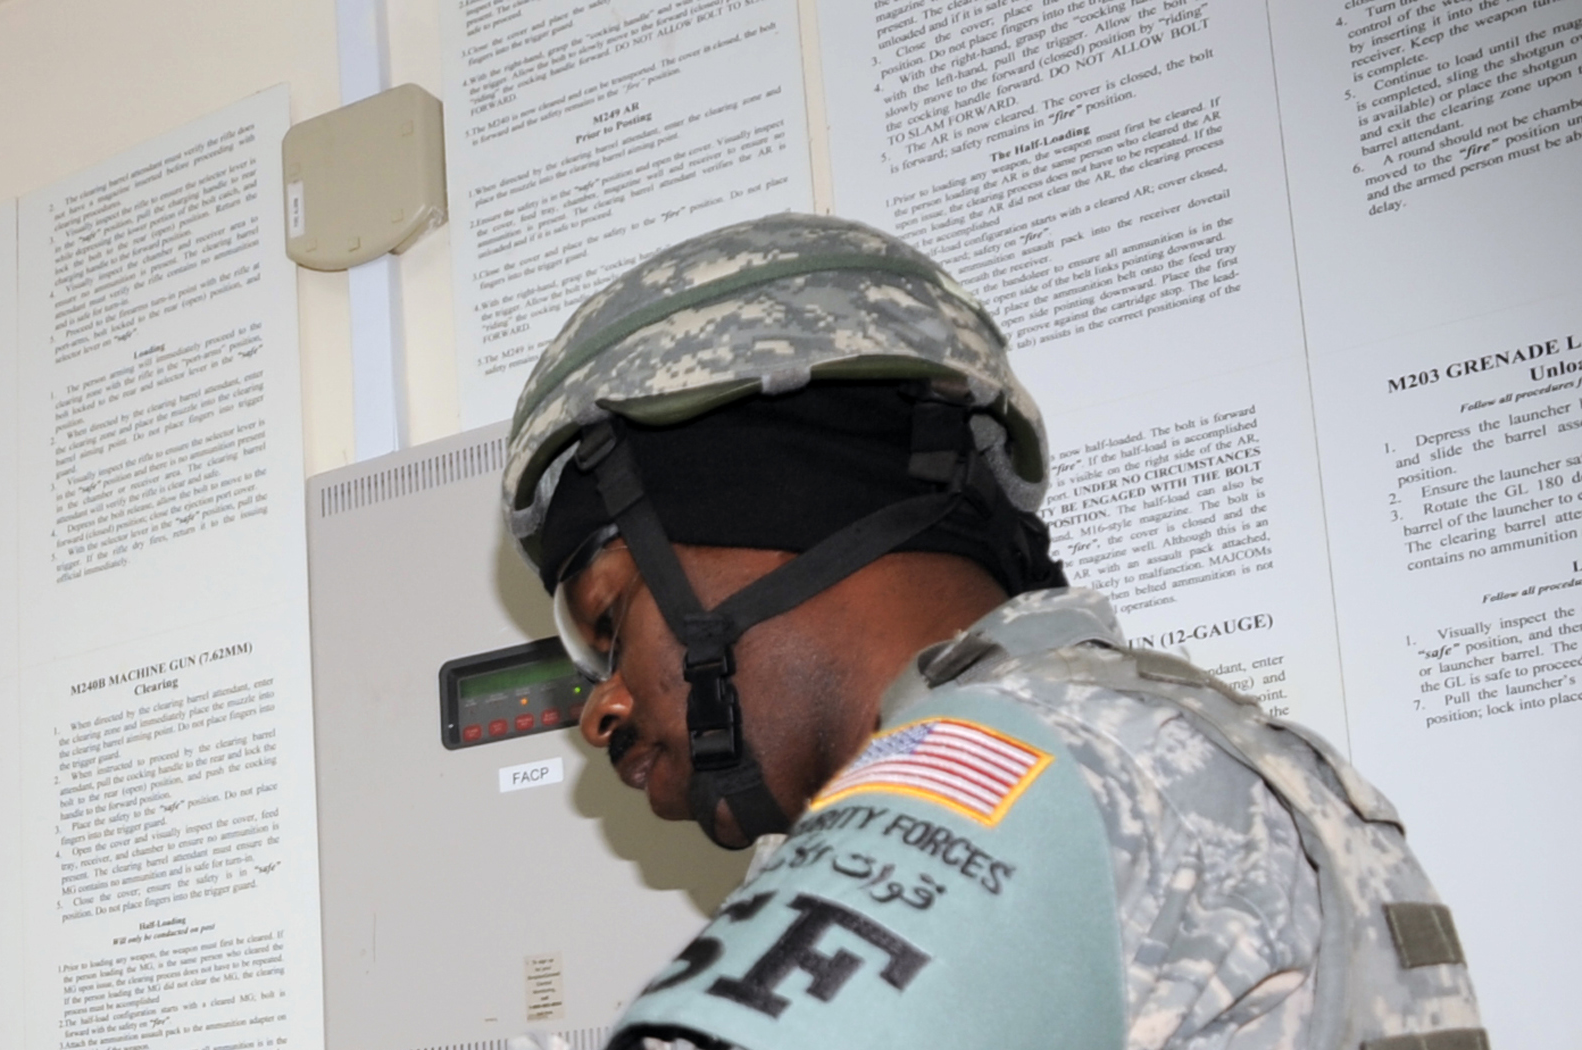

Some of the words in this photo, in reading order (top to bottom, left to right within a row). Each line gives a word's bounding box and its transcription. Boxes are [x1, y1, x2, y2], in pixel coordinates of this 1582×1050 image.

[1410, 32, 1444, 49] Keep
[1449, 24, 1469, 36] the
[1475, 5, 1527, 27] weapon
[1356, 101, 1367, 112] is
[1447, 68, 1479, 84] sling
[1484, 60, 1504, 72] the
[1510, 41, 1564, 64] shotgun
[1374, 67, 1432, 91] Continue
[1436, 60, 1450, 72] to
[1455, 47, 1483, 66] load
[1489, 36, 1519, 55] until
[1525, 30, 1546, 43] the
[1361, 136, 1398, 156] barrel
[1365, 164, 1407, 186] moved
[1413, 162, 1426, 172] to
[1432, 154, 1452, 166] the
[1505, 123, 1560, 148] position
[1383, 152, 1395, 165] A
[1398, 141, 1435, 161] round
[1439, 126, 1483, 149] should
[1487, 121, 1508, 135] not
[1511, 114, 1529, 128] be
[1388, 369, 1439, 393] M203
[1446, 340, 1559, 378] GRENADE
[1460, 400, 1496, 413] Follow
[1499, 393, 1513, 404] all
[1515, 381, 1574, 403] procedures
[1416, 427, 1471, 447] Depress
[1479, 420, 1500, 432] the
[1509, 404, 1571, 426] launcher
[1421, 481, 1469, 498] Ensure
[1473, 474, 1495, 487] the
[1499, 460, 1561, 481] launcher
[1423, 498, 1468, 515] Rotate
[1476, 491, 1497, 504] the
[1504, 483, 1528, 497] GL
[1538, 475, 1564, 491] 180
[1405, 540, 1432, 553] The
[1440, 528, 1497, 547] clearing
[1504, 514, 1546, 534] barrel
[1407, 552, 1464, 571] contains
[1469, 548, 1486, 559] no
[1491, 530, 1578, 555] ammunition
[1437, 622, 1491, 639] Visually
[1500, 612, 1546, 629] inspect
[1554, 607, 1575, 619] the
[1529, 626, 1553, 641] and
[1419, 667, 1432, 677] or
[1439, 656, 1494, 673] launcher
[1551, 641, 1577, 653] The
[1421, 681, 1440, 693] the
[1444, 676, 1466, 689] GL
[1470, 673, 1481, 685] is
[1485, 668, 1511, 682] safe
[1515, 668, 1528, 677] to
[1445, 691, 1470, 706] Pull
[1478, 688, 1498, 700] the
[1487, 701, 1514, 715] lock
[1519, 699, 1545, 710] into
[512, 767, 549, 785] FACP
[883, 813, 1017, 895] FORCES
